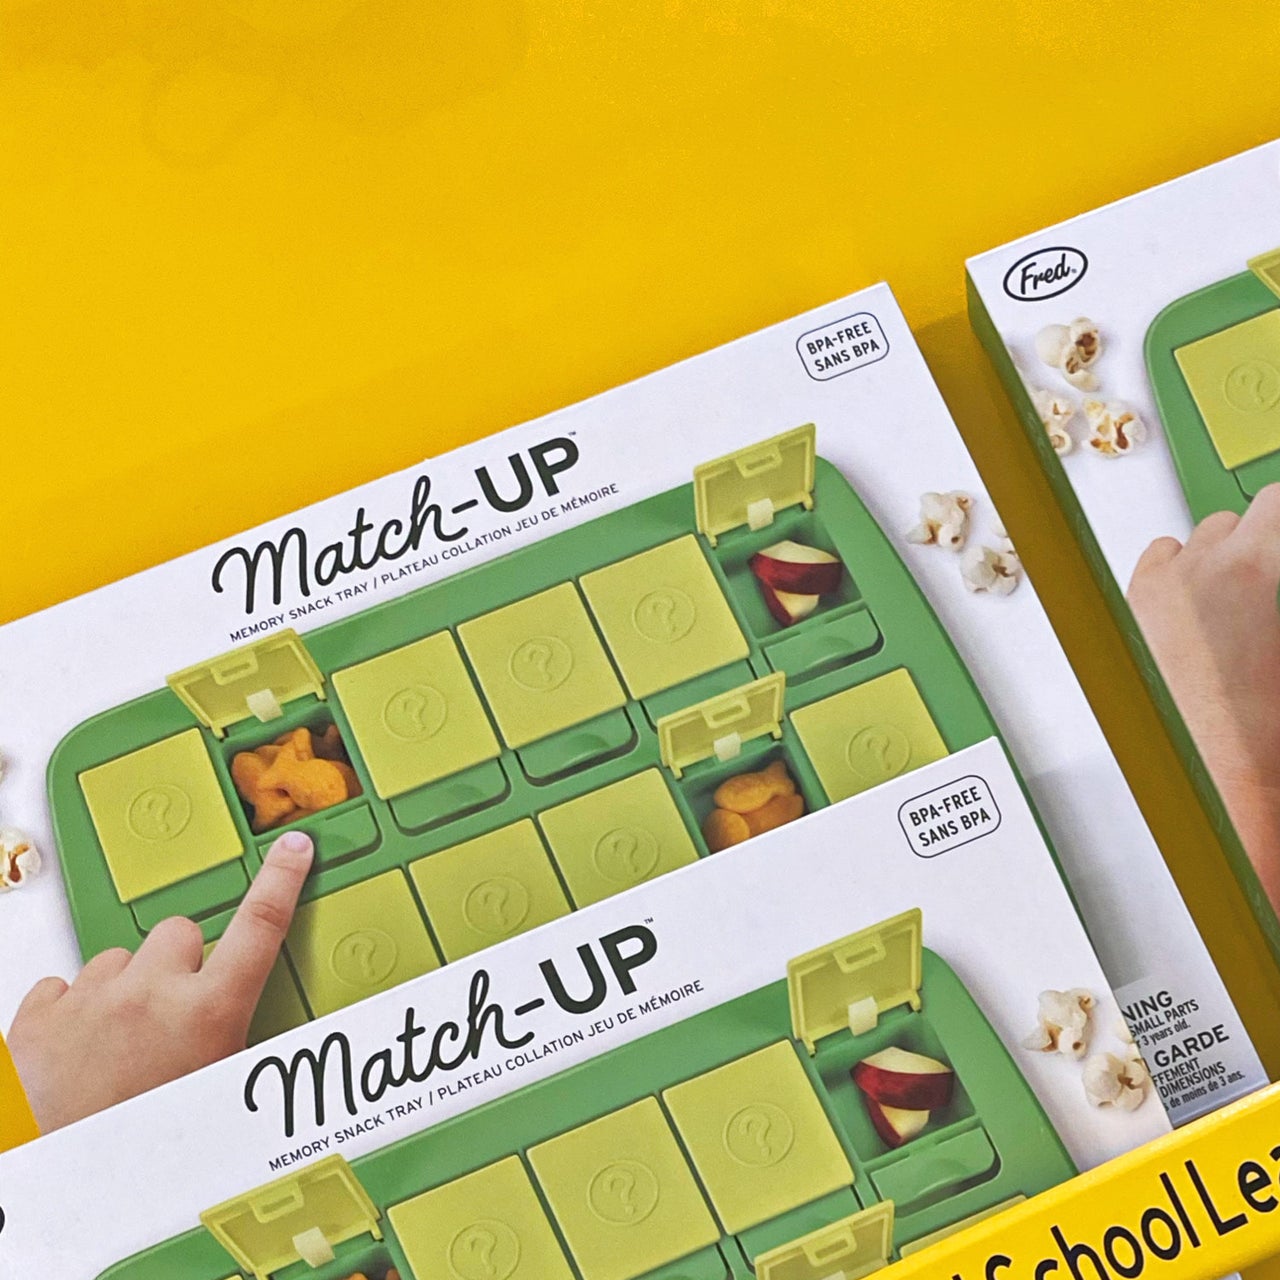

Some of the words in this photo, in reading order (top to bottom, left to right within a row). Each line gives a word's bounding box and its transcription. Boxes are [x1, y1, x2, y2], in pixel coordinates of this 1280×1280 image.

[1020, 253, 1070, 295] Fred
[806, 321, 872, 355] BPA-FREE
[814, 350, 851, 372] SANS
[852, 338, 880, 358] BPA
[230, 614, 283, 641] MEMORY
[289, 597, 333, 619] SNACK
[336, 583, 367, 600] TRAY
[381, 555, 438, 583] PLATEAU
[442, 526, 511, 559] COLLATION
[517, 516, 538, 531] JEU
[542, 508, 558, 520] DE
[561, 484, 618, 512] MÉMOIRE
[909, 786, 982, 826] BPA-FREE
[919, 820, 959, 847] SANS
[960, 807, 991, 830] BPA
[1163, 999, 1199, 1022] PARTS
[1141, 1034, 1150, 1047] 3
[1149, 1026, 1174, 1046] years
[1174, 1018, 1191, 1033] old.
[1154, 1023, 1230, 1068] GARDE
[269, 1137, 329, 1171] MEMORY
[335, 1115, 384, 1143] SNACK
[386, 1097, 422, 1120] TRAY
[438, 1065, 502, 1099] PLATEAU
[506, 1031, 584, 1070] COLLATION
[589, 1018, 613, 1036] JEU
[617, 1008, 637, 1024] DE
[639, 980, 703, 1014] MÉMOIRE
[1159, 1061, 1227, 1098] DIMENSIONS
[1181, 1086, 1208, 1104] moins
[1218, 1075, 1227, 1087] 3
[1227, 1070, 1246, 1083] ans.
